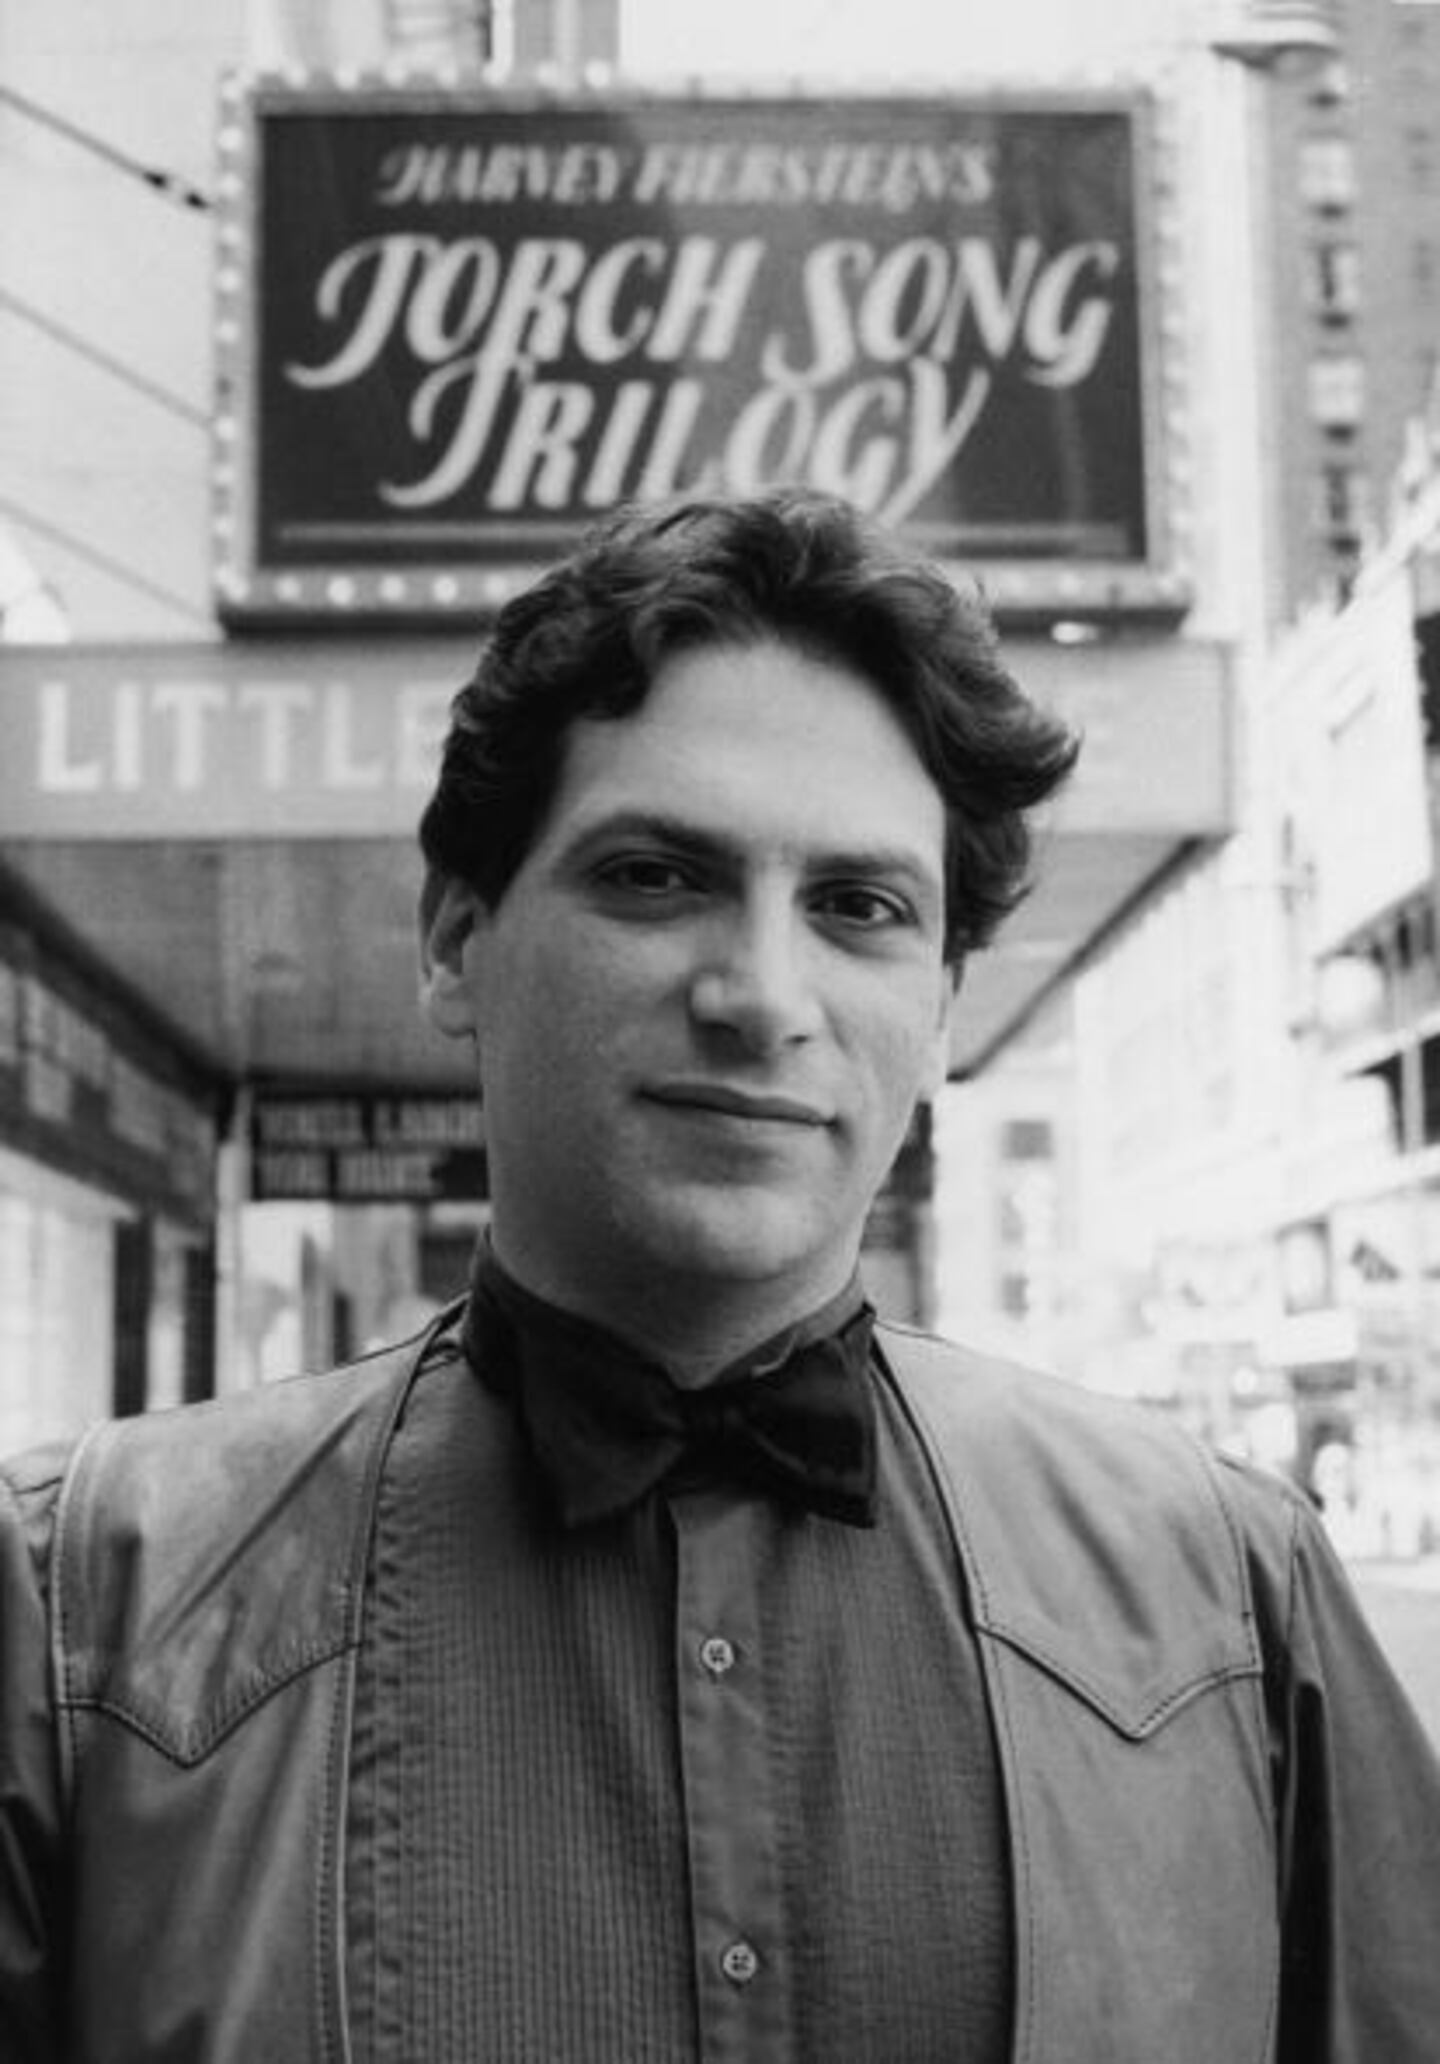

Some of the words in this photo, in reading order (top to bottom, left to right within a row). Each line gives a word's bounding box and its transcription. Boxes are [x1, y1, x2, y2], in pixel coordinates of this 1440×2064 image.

[378, 144, 619, 204] HARVEY
[285, 233, 765, 389] TORCH
[763, 236, 1119, 388] SONG
[378, 353, 989, 529] TRILOGY
